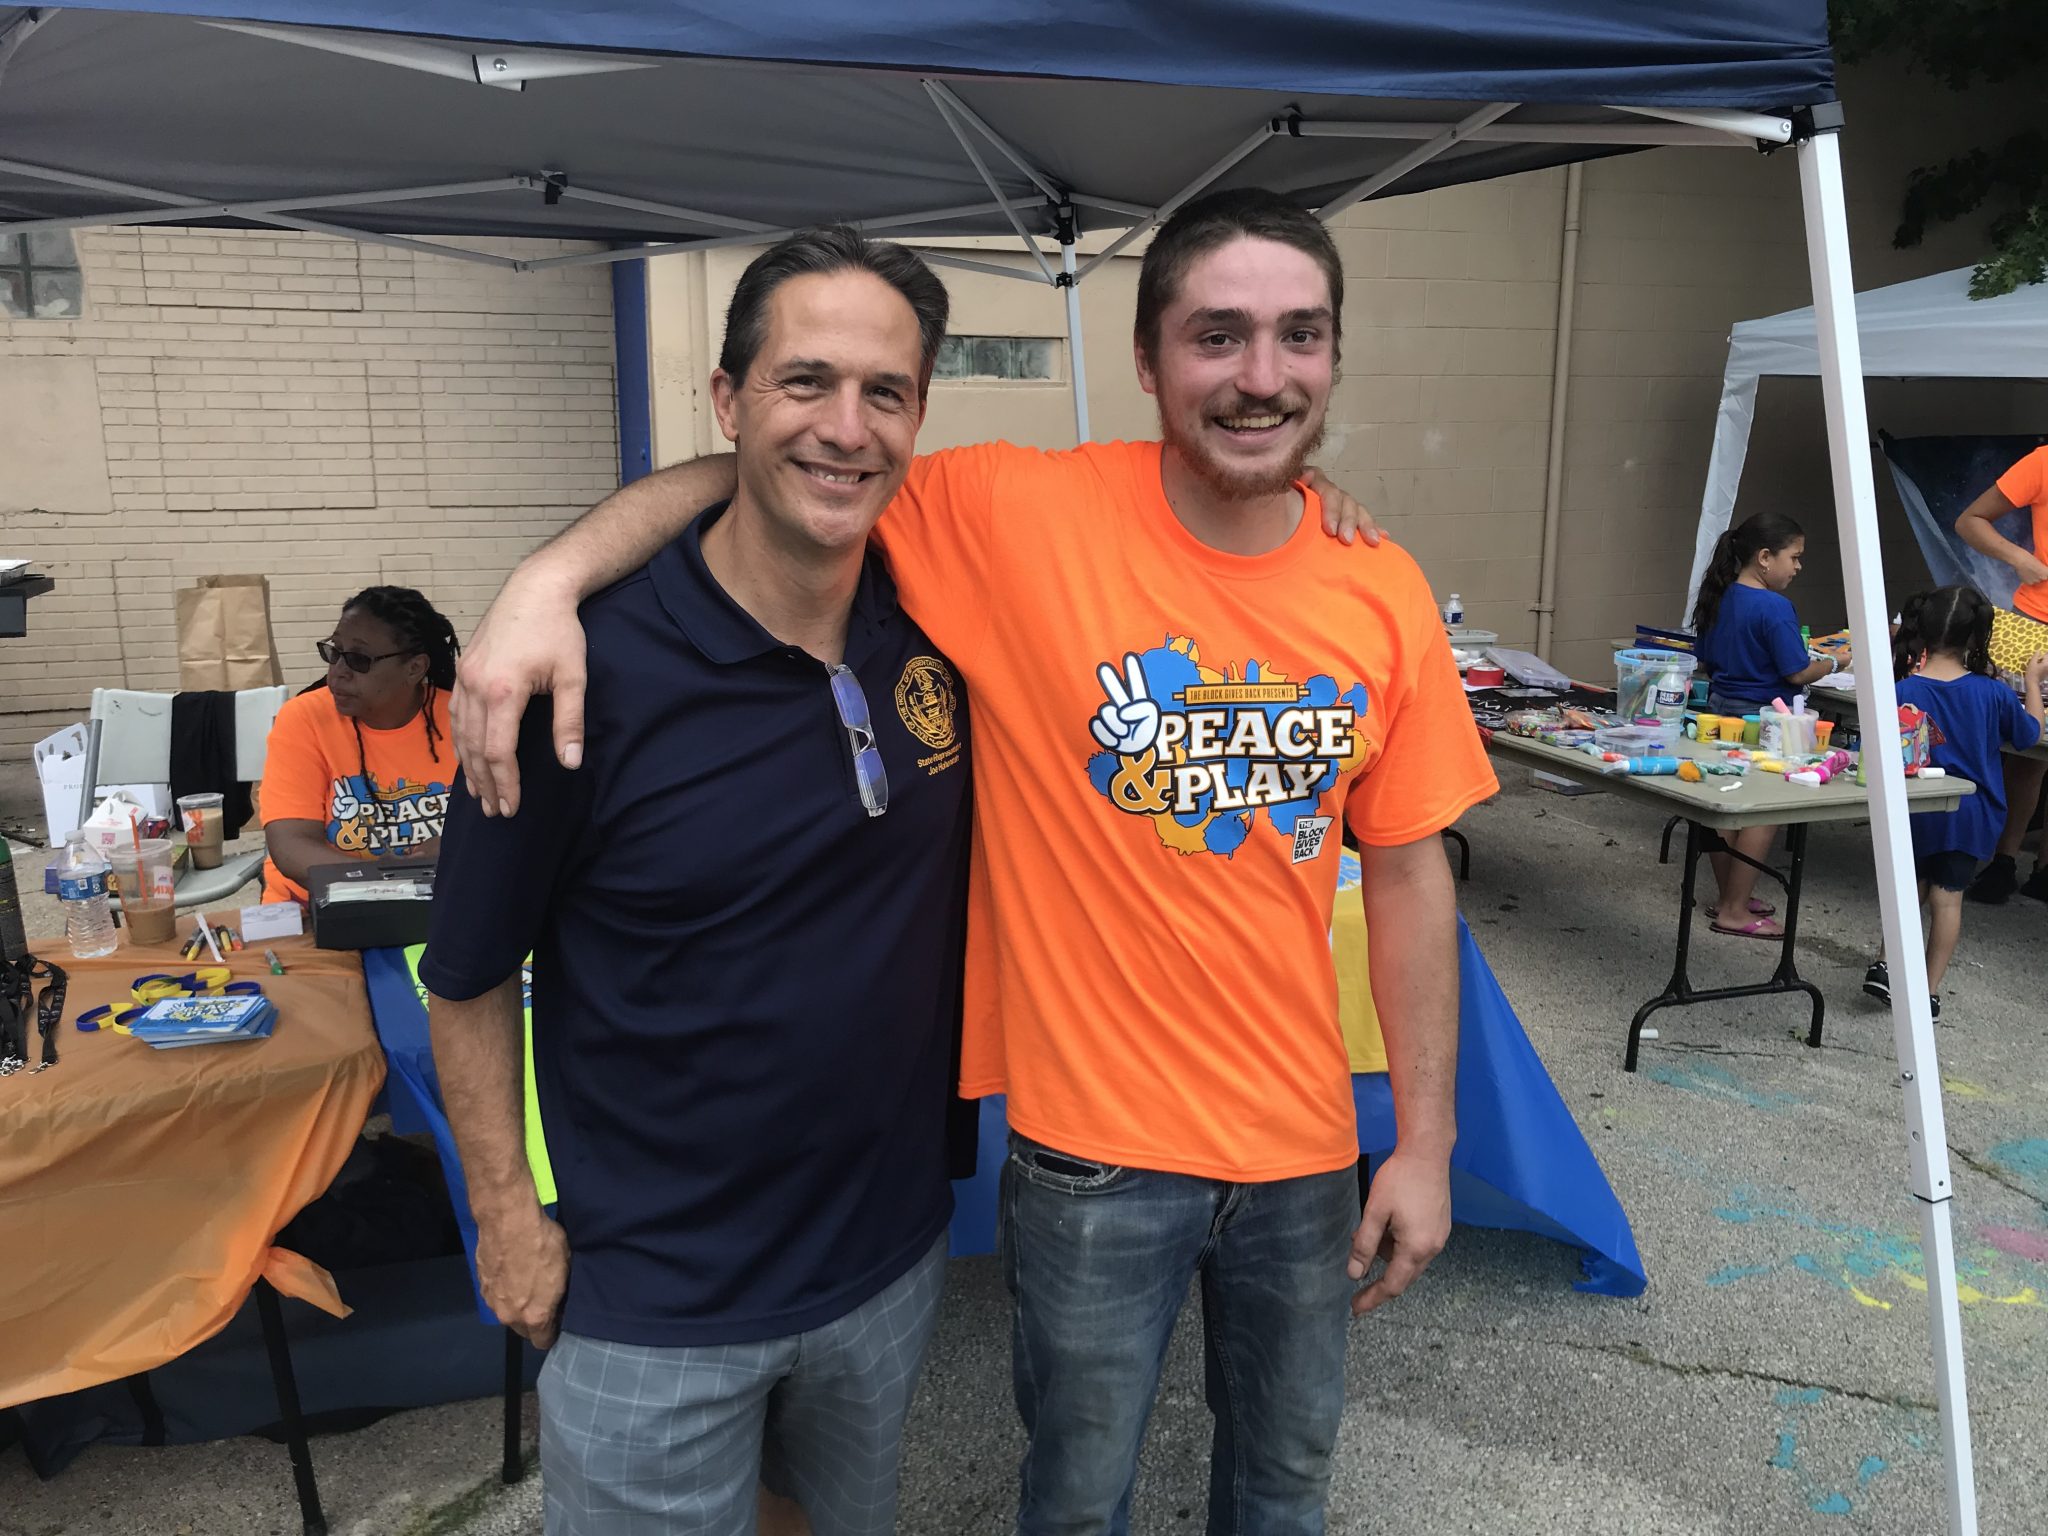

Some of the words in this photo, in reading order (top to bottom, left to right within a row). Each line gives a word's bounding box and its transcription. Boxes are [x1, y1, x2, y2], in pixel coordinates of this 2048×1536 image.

[1190, 690, 1200, 701] THE
[1202, 689, 1223, 700] BLOCK
[1224, 688, 1243, 700] GIVES
[1245, 688, 1260, 699] BACK
[1262, 687, 1294, 699] PRESENTS
[1155, 708, 1353, 762] PEACE
[917, 757, 933, 768] State
[928, 766, 938, 776] Joe
[1110, 747, 1171, 812] &
[1174, 763, 1329, 812] PLAY
[337, 816, 368, 850] &
[1297, 827, 1326, 840] BLOCK
[1295, 837, 1321, 849] GIVES
[1294, 847, 1315, 859] BACK
